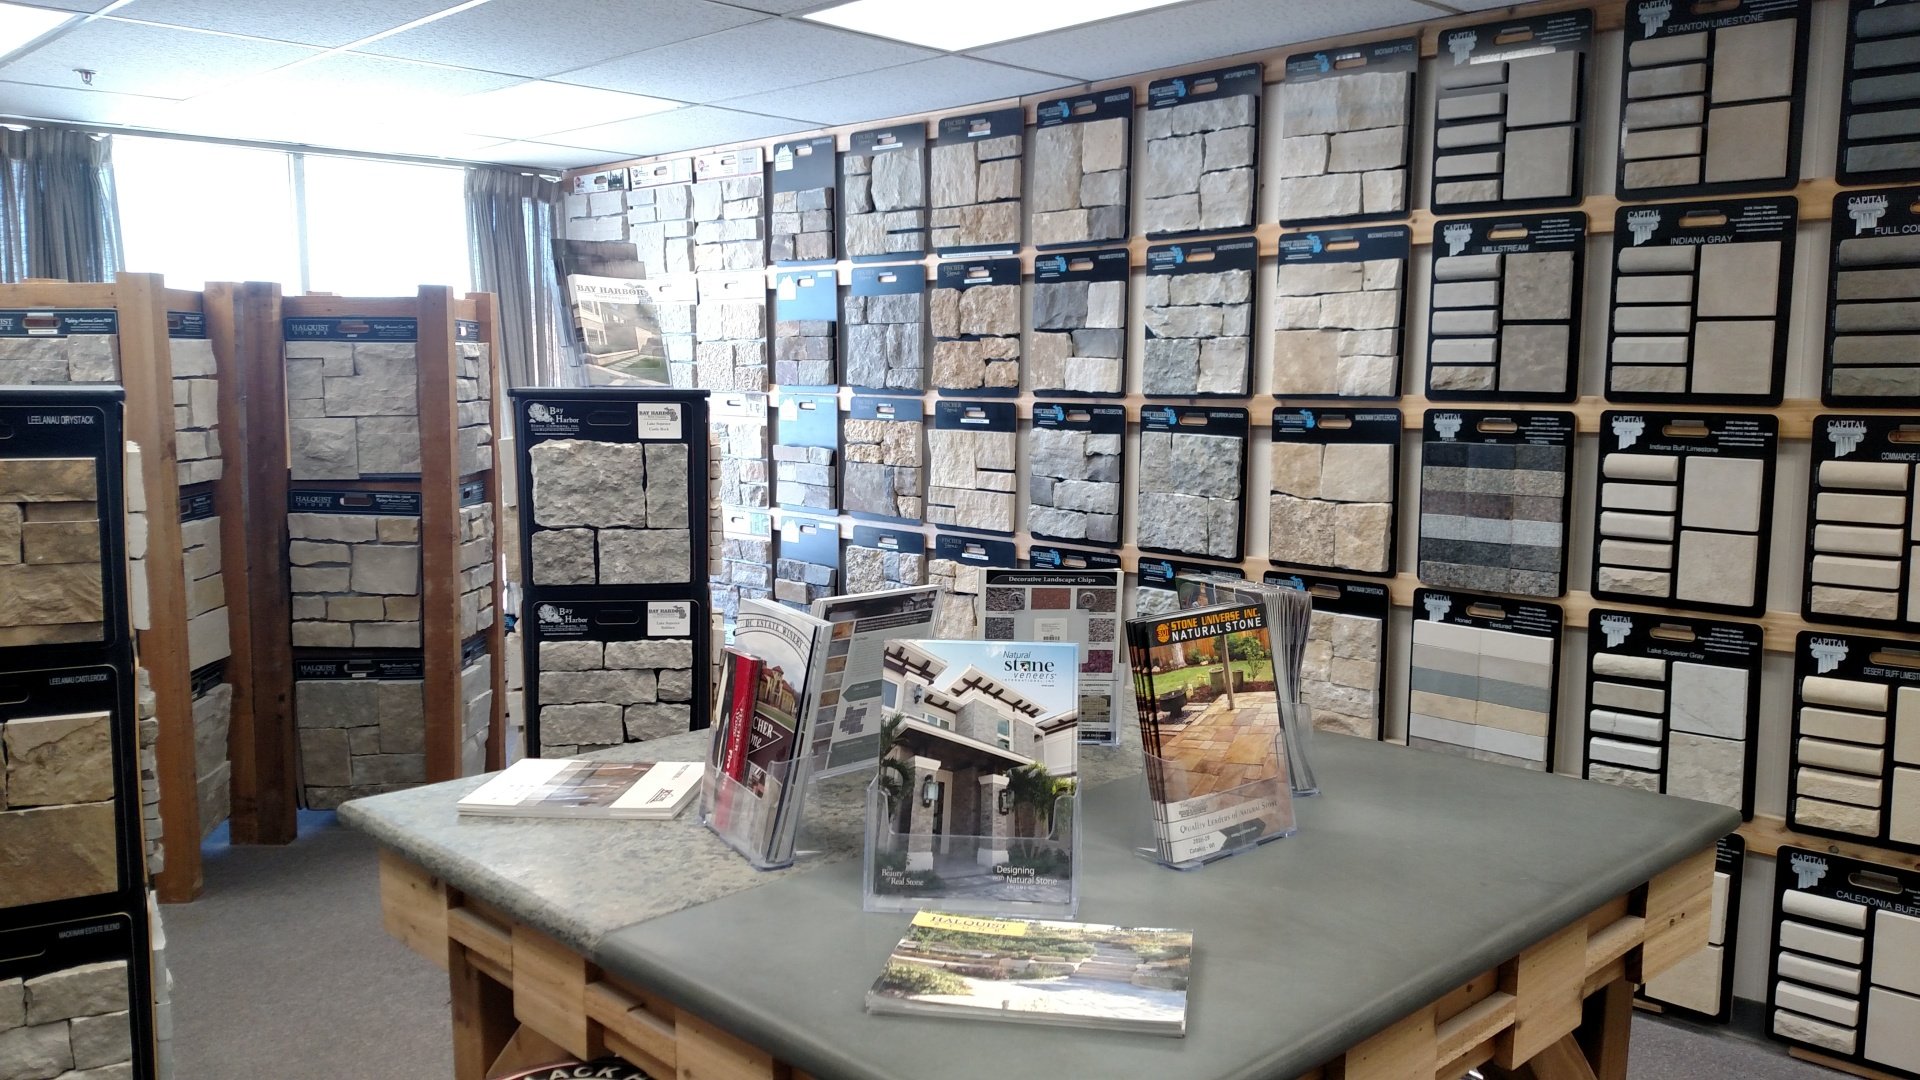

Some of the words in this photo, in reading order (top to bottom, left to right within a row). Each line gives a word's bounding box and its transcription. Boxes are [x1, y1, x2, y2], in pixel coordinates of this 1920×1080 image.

[1638, 0, 1672, 10] CAPITAL
[1667, 22, 1709, 34] STANTON
[1710, 13, 1765, 28] LIMESTONE
[1848, 194, 1888, 205] CAPITAL
[1627, 209, 1660, 219] CAPITAL
[1443, 223, 1471, 231] CAPITAL
[1874, 226, 1900, 235] FULL
[1670, 235, 1706, 245] INDIANA
[1707, 235, 1733, 243] GRAY
[1482, 244, 1529, 253] MILLSTREAM
[576, 284, 597, 293] BAY
[599, 286, 645, 296] HARBOR
[291, 324, 329, 332] HALQUIST
[549, 406, 564, 415] Bay
[27, 416, 60, 425] LEELANAU
[61, 415, 94, 425] DRYSTACK
[555, 415, 580, 424] Harbor
[1611, 415, 1645, 423] CAPITAL
[1827, 419, 1867, 428] CAPITAL
[1649, 443, 1672, 451] Indiana
[1686, 446, 1719, 454] Limestone
[1881, 452, 1917, 461] COMMANCHE
[1043, 576, 1076, 584] Landscape
[1423, 592, 1450, 601] CAPITAL
[558, 607, 573, 616] Bay
[565, 616, 588, 624] Harbor
[1171, 617, 1198, 631] STONE
[1201, 610, 1240, 626] UNIVERSE
[1243, 608, 1261, 618] INC.
[1600, 614, 1632, 624] CAPITAL
[756, 619, 782, 632] ESTATE
[1172, 623, 1223, 642] NATURAL
[1225, 617, 1262, 632] STONE
[1489, 622, 1512, 630] Textured
[1810, 637, 1848, 648] CAPITAL
[1003, 650, 1032, 659] Natural
[1662, 648, 1689, 658] Superior
[1689, 651, 1705, 660] Gray
[1013, 672, 1055, 680] veneers
[1863, 667, 1884, 676] DESERT
[1885, 669, 1900, 678] BUFF
[75, 673, 108, 684] CASTLEROCK
[752, 716, 774, 739] CHER
[1791, 852, 1828, 866] CAPITAL
[881, 868, 904, 878] Beauty
[996, 865, 1035, 877] Designing
[890, 877, 905, 886] Real
[905, 878, 924, 886] Stone
[1006, 875, 1034, 884] Natural
[1035, 876, 1058, 886] Stone
[1836, 890, 1893, 909] CALEDONIA
[1894, 903, 1920, 916] BUFF
[930, 916, 1009, 930] HALQUIST
[85, 925, 103, 935] ESTATE
[103, 922, 120, 932] BLEND
